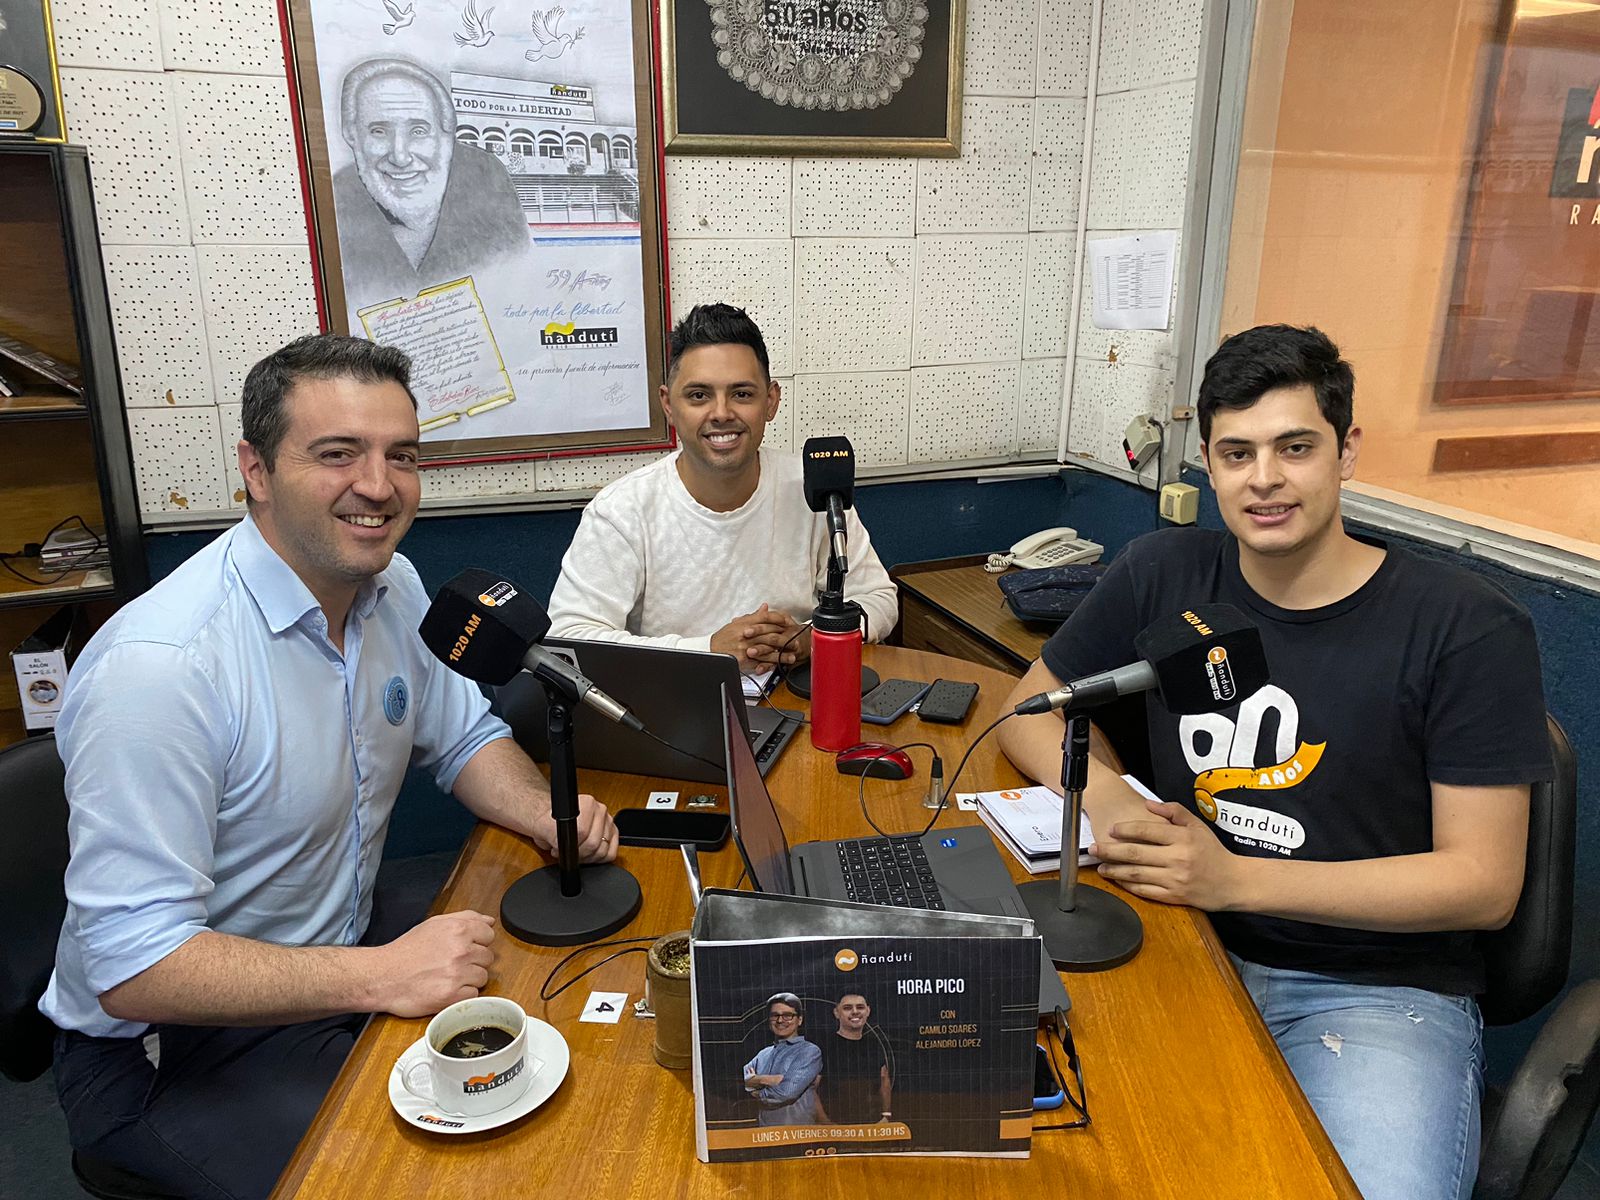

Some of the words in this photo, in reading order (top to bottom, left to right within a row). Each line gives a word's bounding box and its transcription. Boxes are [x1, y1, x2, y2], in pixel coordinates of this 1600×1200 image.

[454, 98, 487, 109] TODO
[519, 104, 572, 116] LIBERTAD
[545, 268, 572, 290] 59
[503, 303, 528, 318] todo
[529, 306, 549, 324] por
[550, 300, 567, 321] la
[570, 300, 626, 321] libertad
[809, 451, 831, 459] 1020
[1181, 610, 1202, 625] 1020
[1194, 623, 1214, 636] AM
[449, 635, 469, 661] 1020
[464, 613, 482, 637] AM
[1258, 759, 1303, 786] AÑOS
[1233, 835, 1256, 847] Radio
[1259, 840, 1278, 852] 1020
[1278, 847, 1292, 856] AM
[861, 951, 913, 964] ñandutí
[897, 979, 933, 995] HORA
[935, 978, 965, 994] PICO
[595, 1001, 615, 1013] 4
[940, 1009, 956, 1019] CON
[919, 1025, 948, 1035] CAMILO
[948, 1023, 978, 1034] SOARES
[915, 1039, 957, 1049] ALEJANDRO
[958, 1038, 981, 1048] LOPEZ
[752, 1130, 781, 1143] LUNES
[782, 1130, 789, 1141] A
[790, 1128, 829, 1139] VIERNES
[830, 1128, 856, 1138] 09:30
[857, 1127, 864, 1137] A
[867, 1126, 892, 1137] 11:30
[893, 1126, 905, 1136] HS
